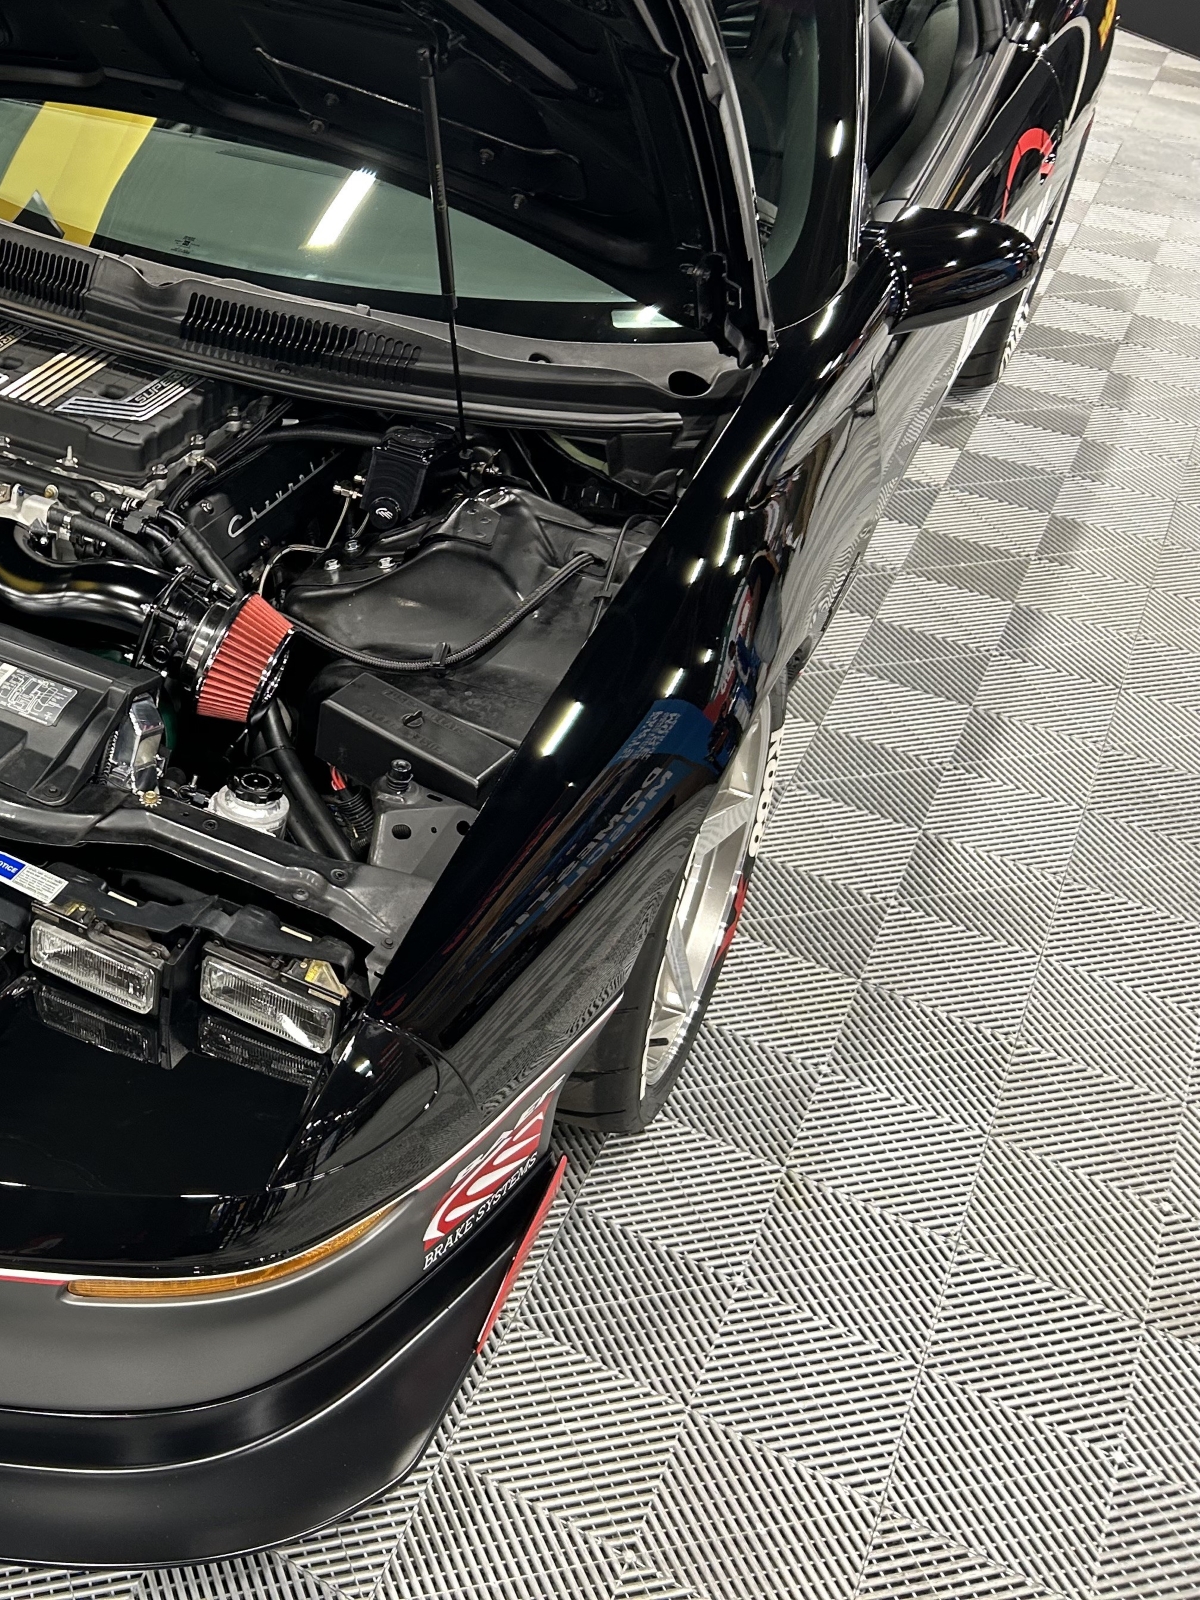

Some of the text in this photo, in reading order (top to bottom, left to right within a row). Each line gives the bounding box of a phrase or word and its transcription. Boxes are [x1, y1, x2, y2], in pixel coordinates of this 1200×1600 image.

[134, 371, 185, 404] SUPER
[421, 1151, 539, 1271] BRAKE SYSTEMS
